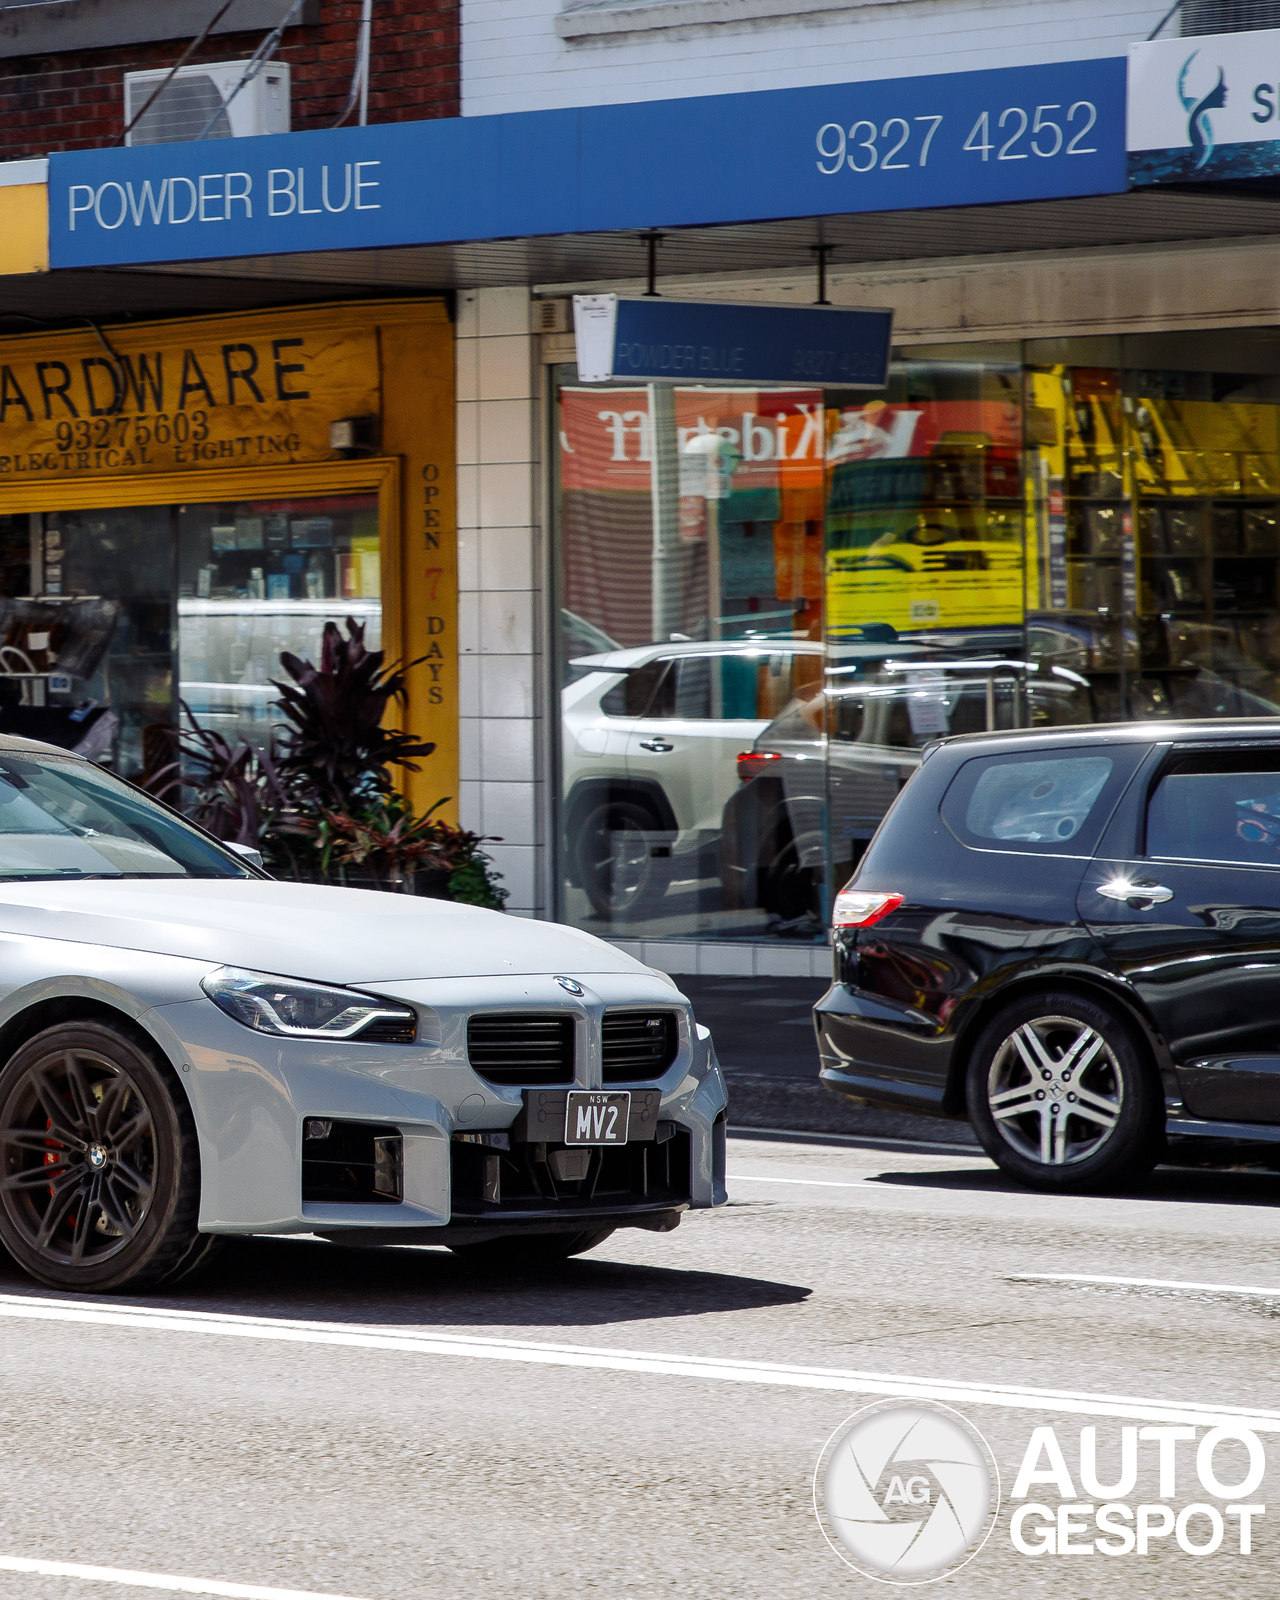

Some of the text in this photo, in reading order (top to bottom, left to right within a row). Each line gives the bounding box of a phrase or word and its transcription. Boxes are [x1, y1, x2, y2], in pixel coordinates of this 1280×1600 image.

[1250, 82, 1280, 125] S
[815, 100, 1098, 175] 9327 4252
[68, 160, 382, 231] POWDER BLUE
[618, 342, 695, 370] POWDER
[699, 346, 746, 373] BLUE
[55, 409, 210, 452] 93275603
[172, 432, 301, 464] LIGHTING
[421, 463, 446, 705] OPEN 7 DAYS
[589, 1095, 609, 1104] NSW
[576, 1105, 619, 1139] MV2
